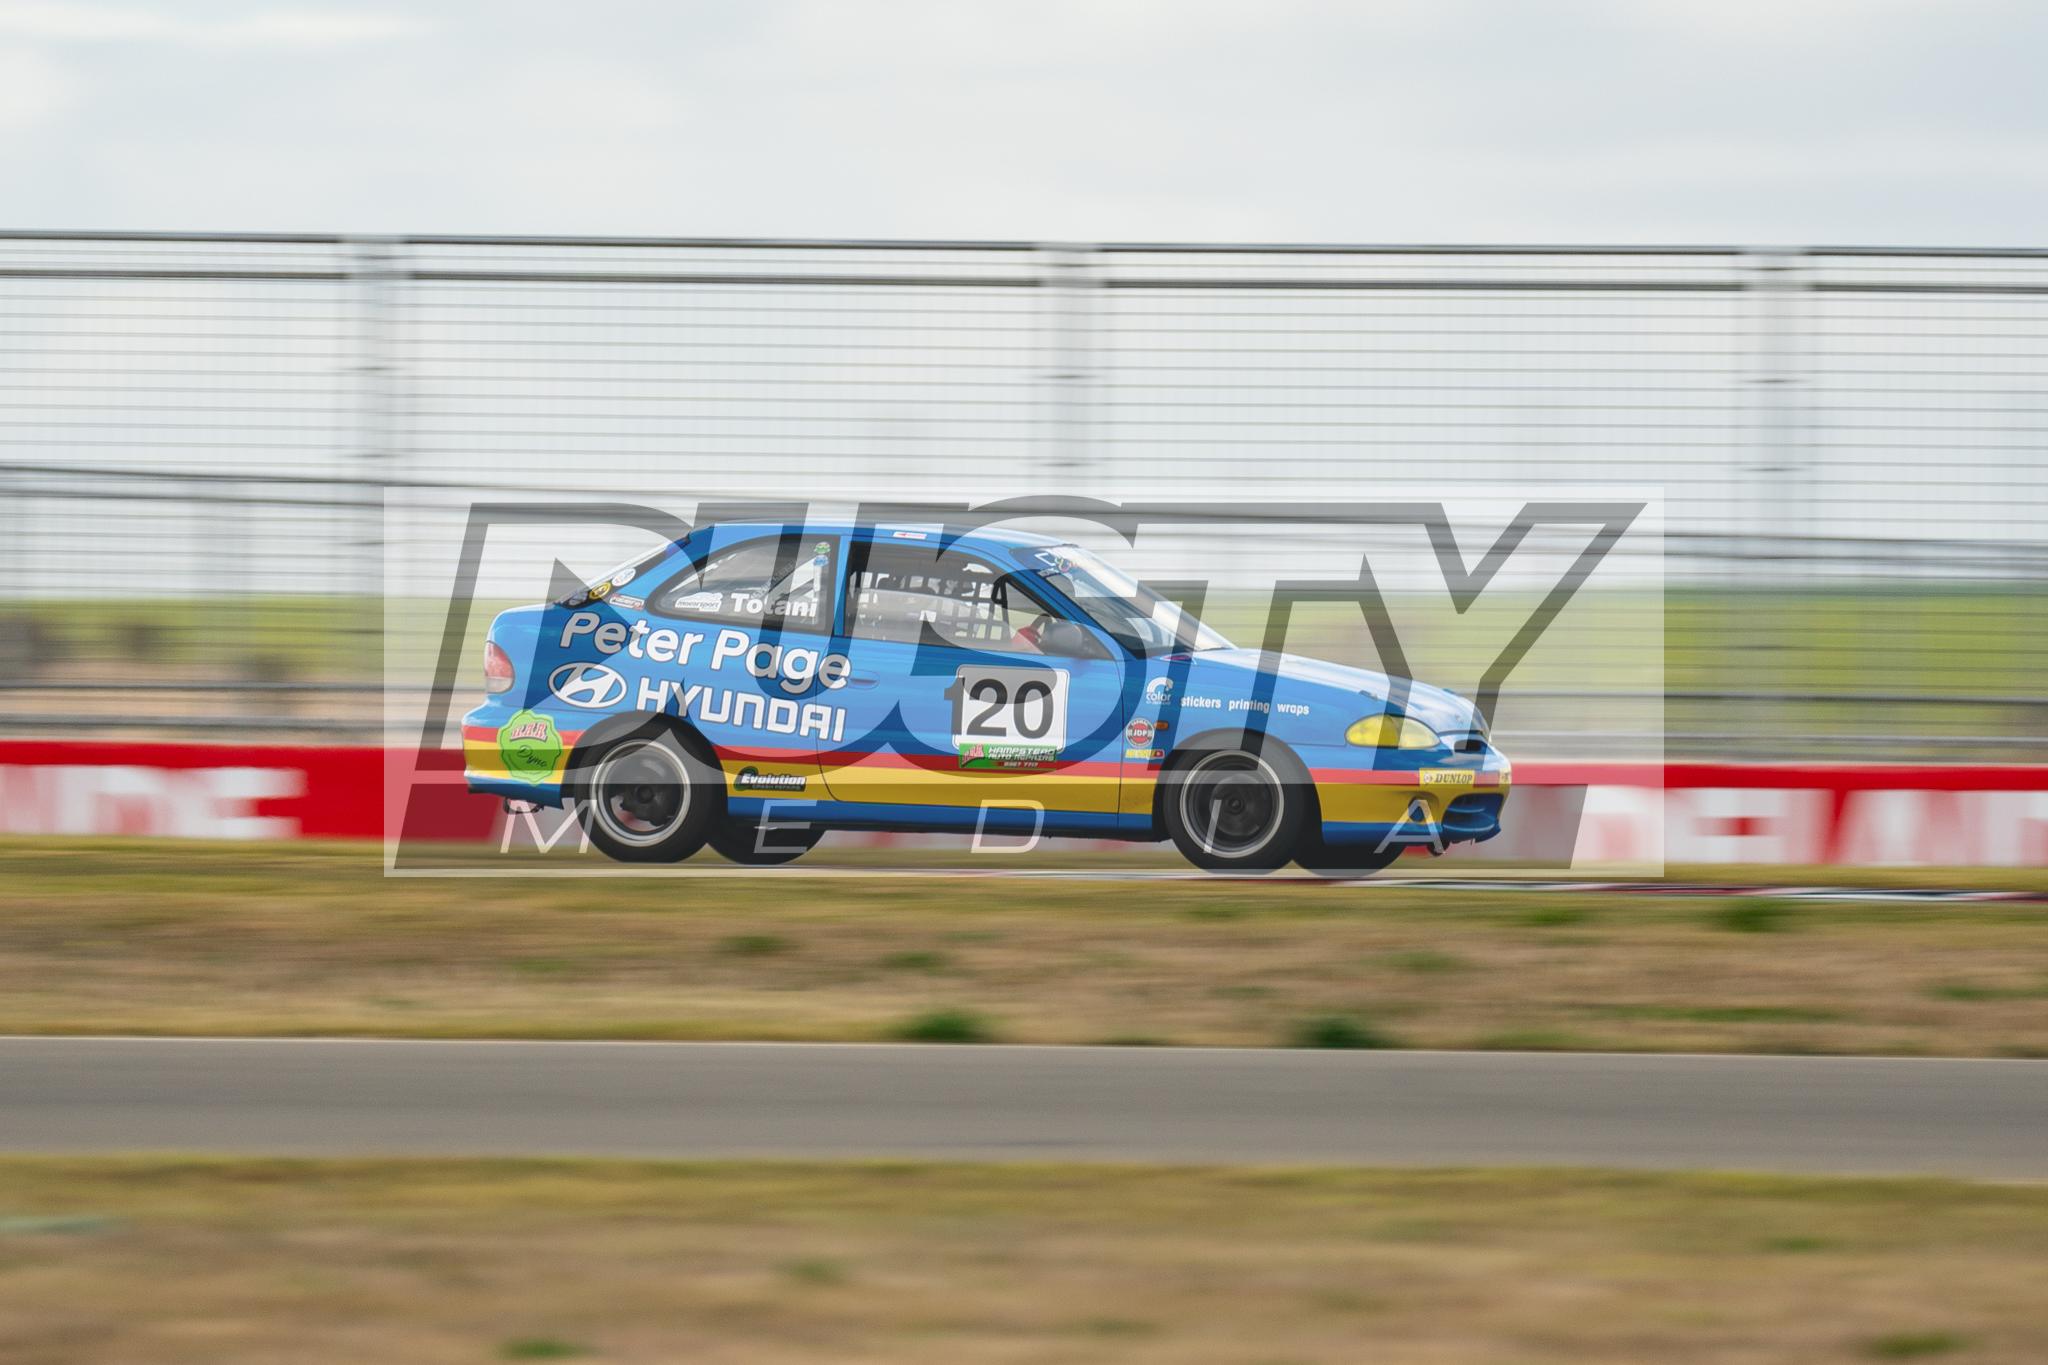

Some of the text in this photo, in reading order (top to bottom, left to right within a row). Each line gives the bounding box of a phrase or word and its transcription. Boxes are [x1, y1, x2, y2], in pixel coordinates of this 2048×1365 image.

[730, 592, 818, 618] Totani
[559, 612, 852, 694] Peter Page
[636, 676, 847, 742] HYUNDAI
[944, 677, 1054, 739] 120
[1180, 696, 1310, 716] stickers printing wraps
[741, 774, 806, 785] Evolution
[1434, 773, 1473, 784] DUNLOP
